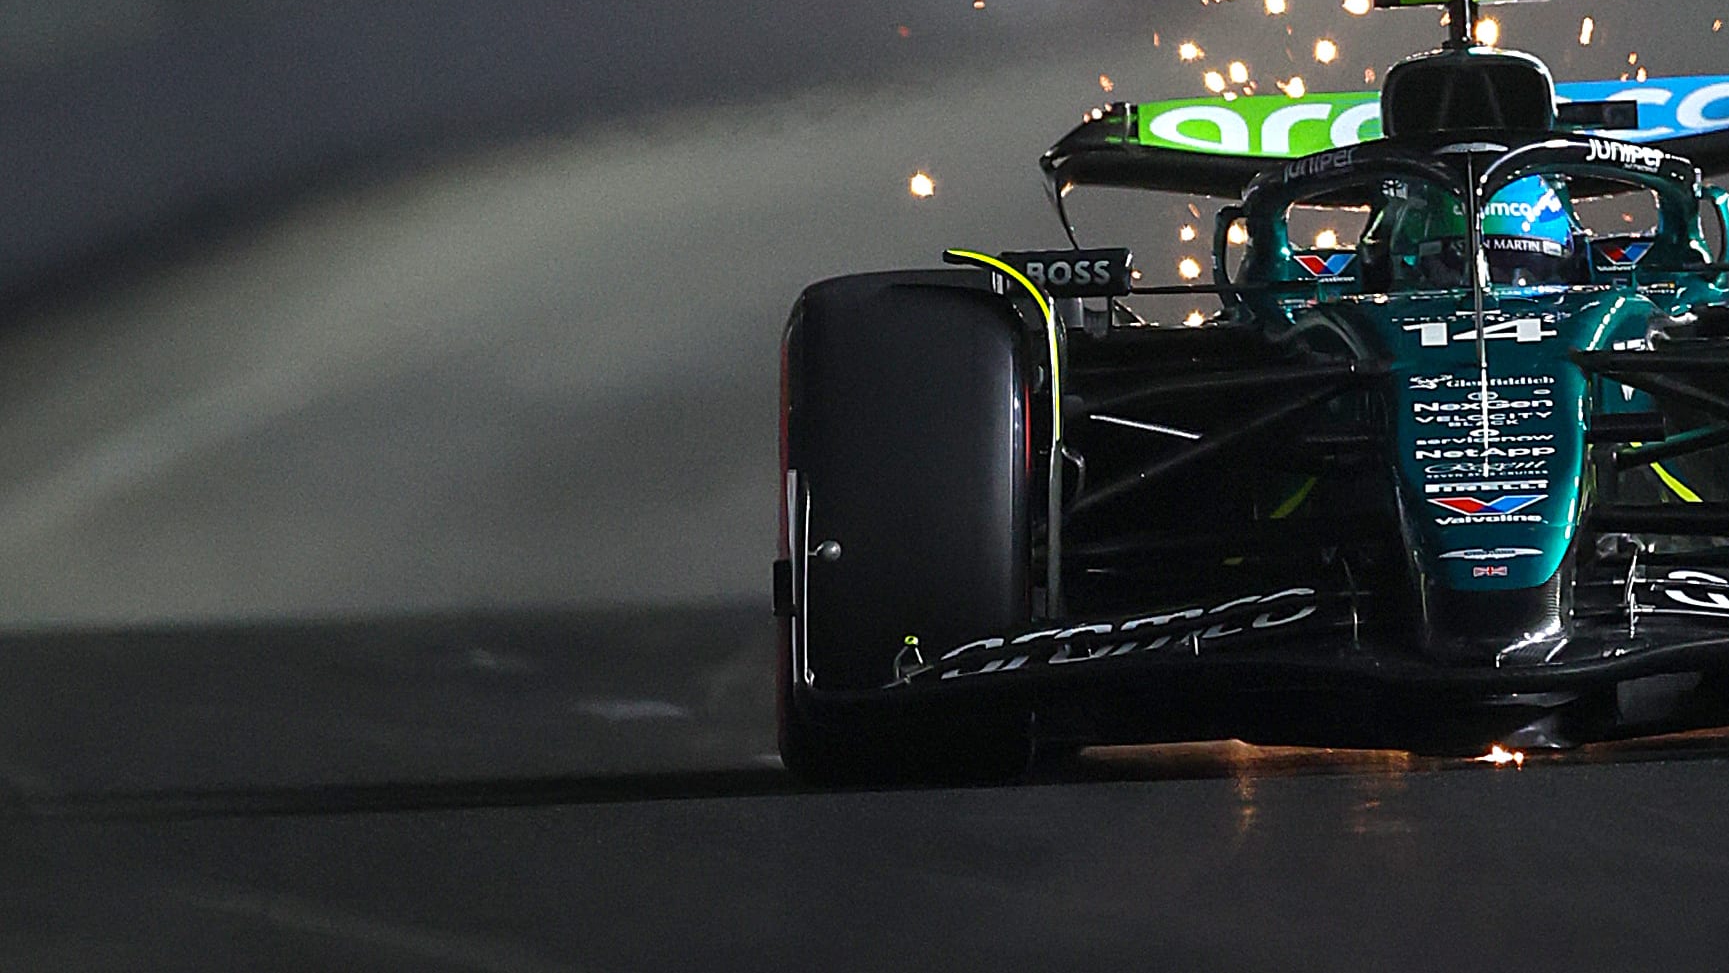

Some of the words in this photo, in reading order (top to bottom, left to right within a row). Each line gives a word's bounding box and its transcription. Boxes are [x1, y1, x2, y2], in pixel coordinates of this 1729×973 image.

[1026, 260, 1111, 285] BOSS
[1402, 318, 1557, 347] 14
[1413, 399, 1553, 412] NexGen
[1415, 411, 1552, 423] VELOCITY
[1415, 447, 1555, 459] NetApp
[1435, 514, 1542, 525] Valvoline
